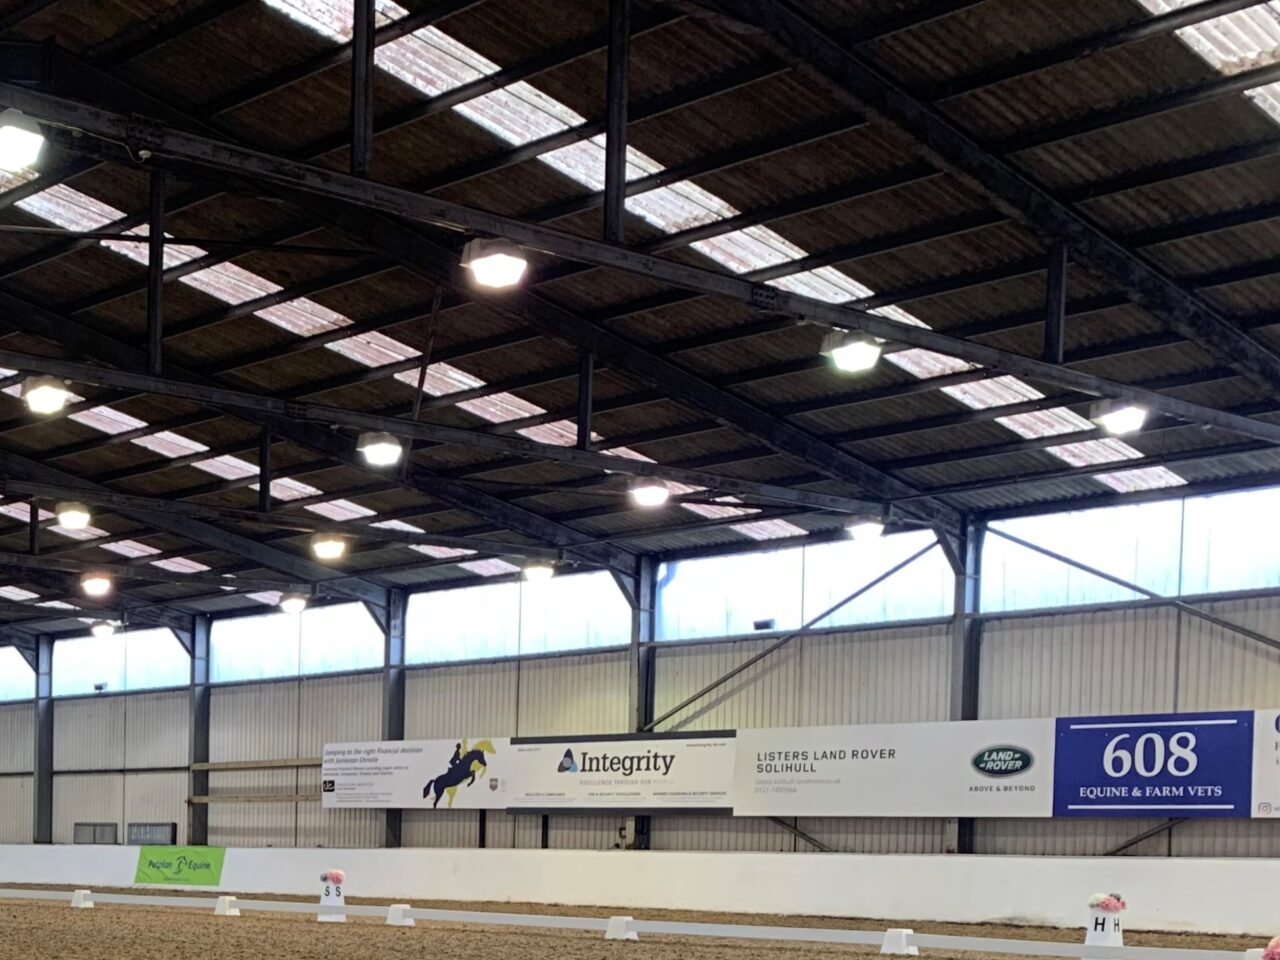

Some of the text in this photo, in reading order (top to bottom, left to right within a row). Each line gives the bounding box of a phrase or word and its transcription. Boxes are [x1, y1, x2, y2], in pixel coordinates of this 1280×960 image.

[757, 748, 896, 762] LISTERS LAND ROVER
[983, 751, 1014, 761] LAND
[1102, 731, 1198, 778] 608
[580, 749, 676, 777] Integrity
[756, 762, 817, 773] SOLIHULL
[985, 760, 1023, 770] ROVER
[1079, 785, 1223, 799] EQUINE & FARM VETS
[188, 860, 211, 872] Equine
[324, 885, 330, 897] S
[335, 885, 342, 897] S
[1094, 917, 1106, 932] H
[1113, 917, 1120, 932] H
